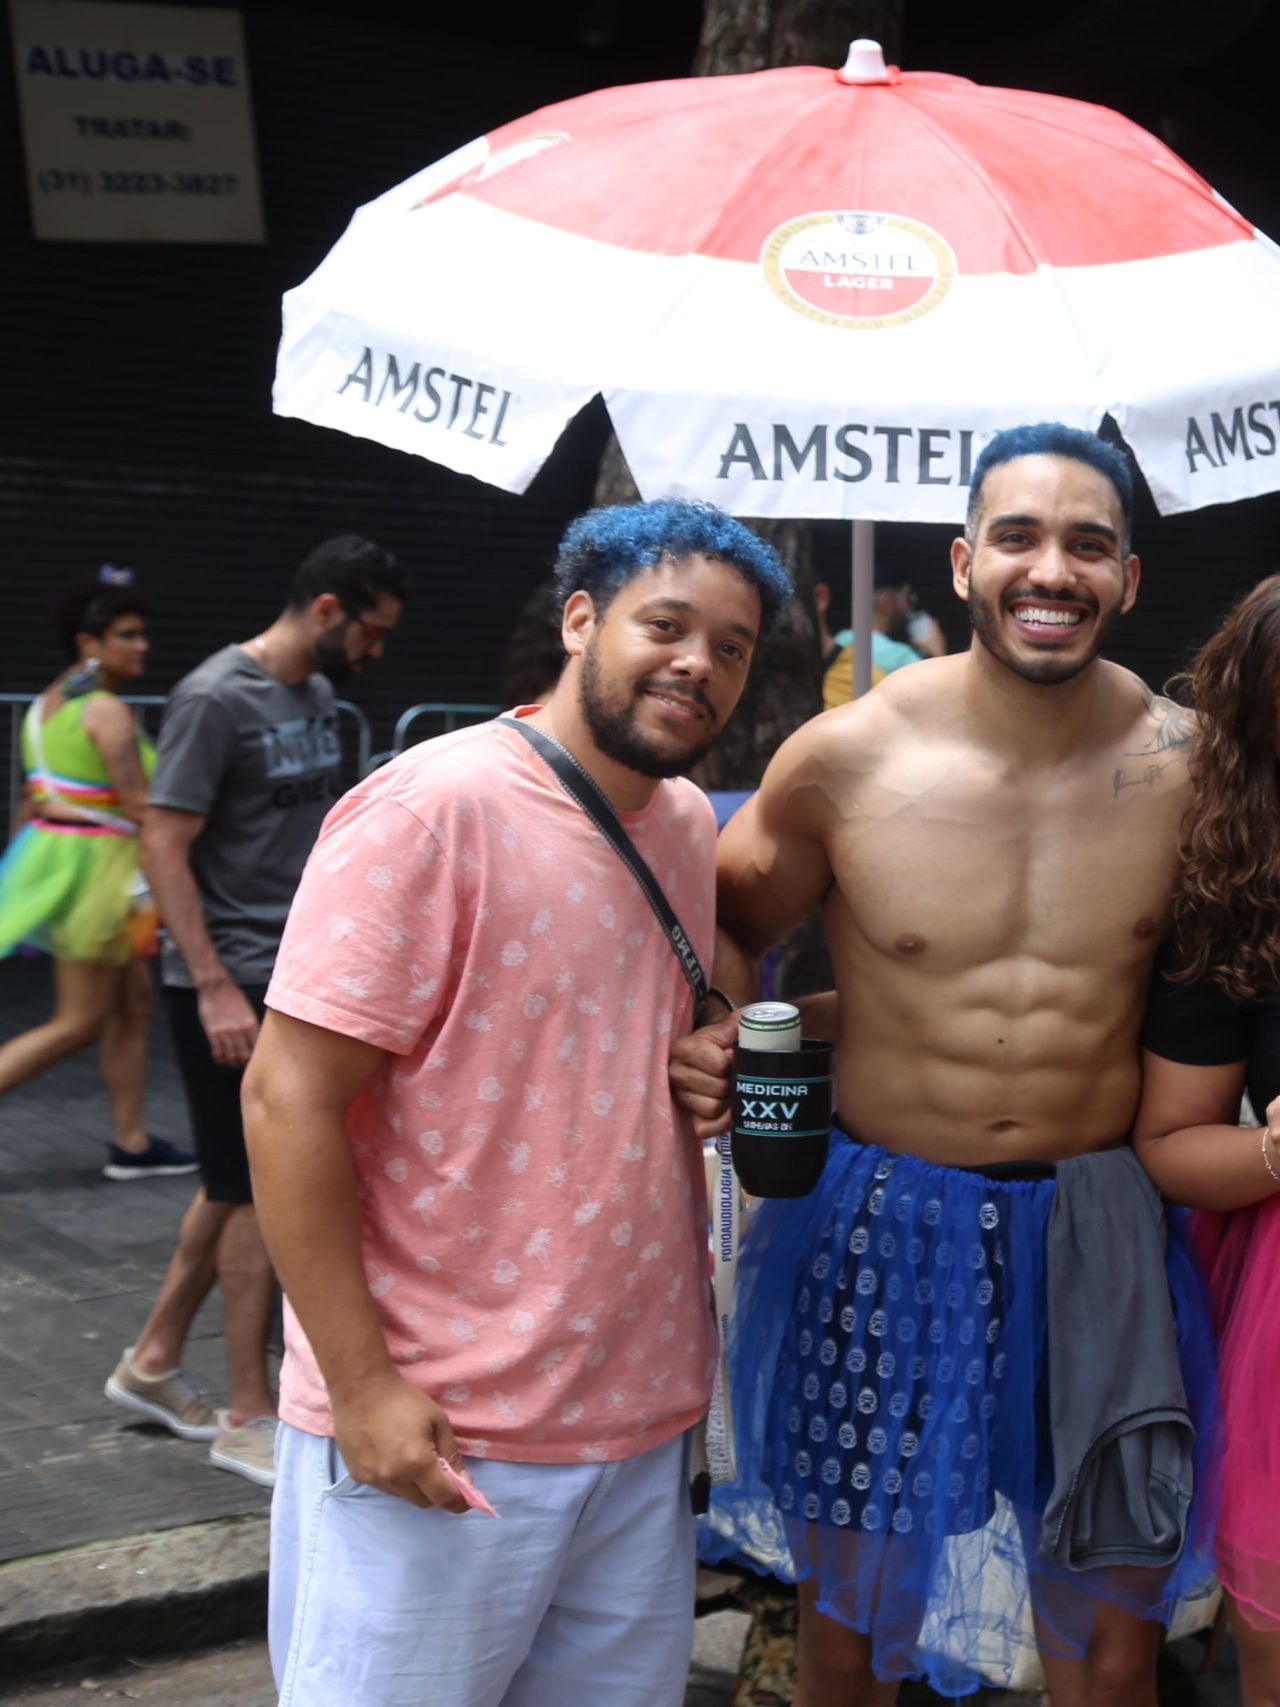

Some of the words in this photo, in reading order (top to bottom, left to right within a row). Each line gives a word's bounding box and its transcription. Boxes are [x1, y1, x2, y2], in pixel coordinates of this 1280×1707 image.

[26, 46, 238, 87] ALUGA-SE
[800, 249, 919, 271] AMSTEL
[823, 275, 895, 291] LAGER
[337, 346, 514, 447] AMSTEL
[736, 1081, 808, 1097] MEDICINA
[741, 1099, 799, 1120] XXV
